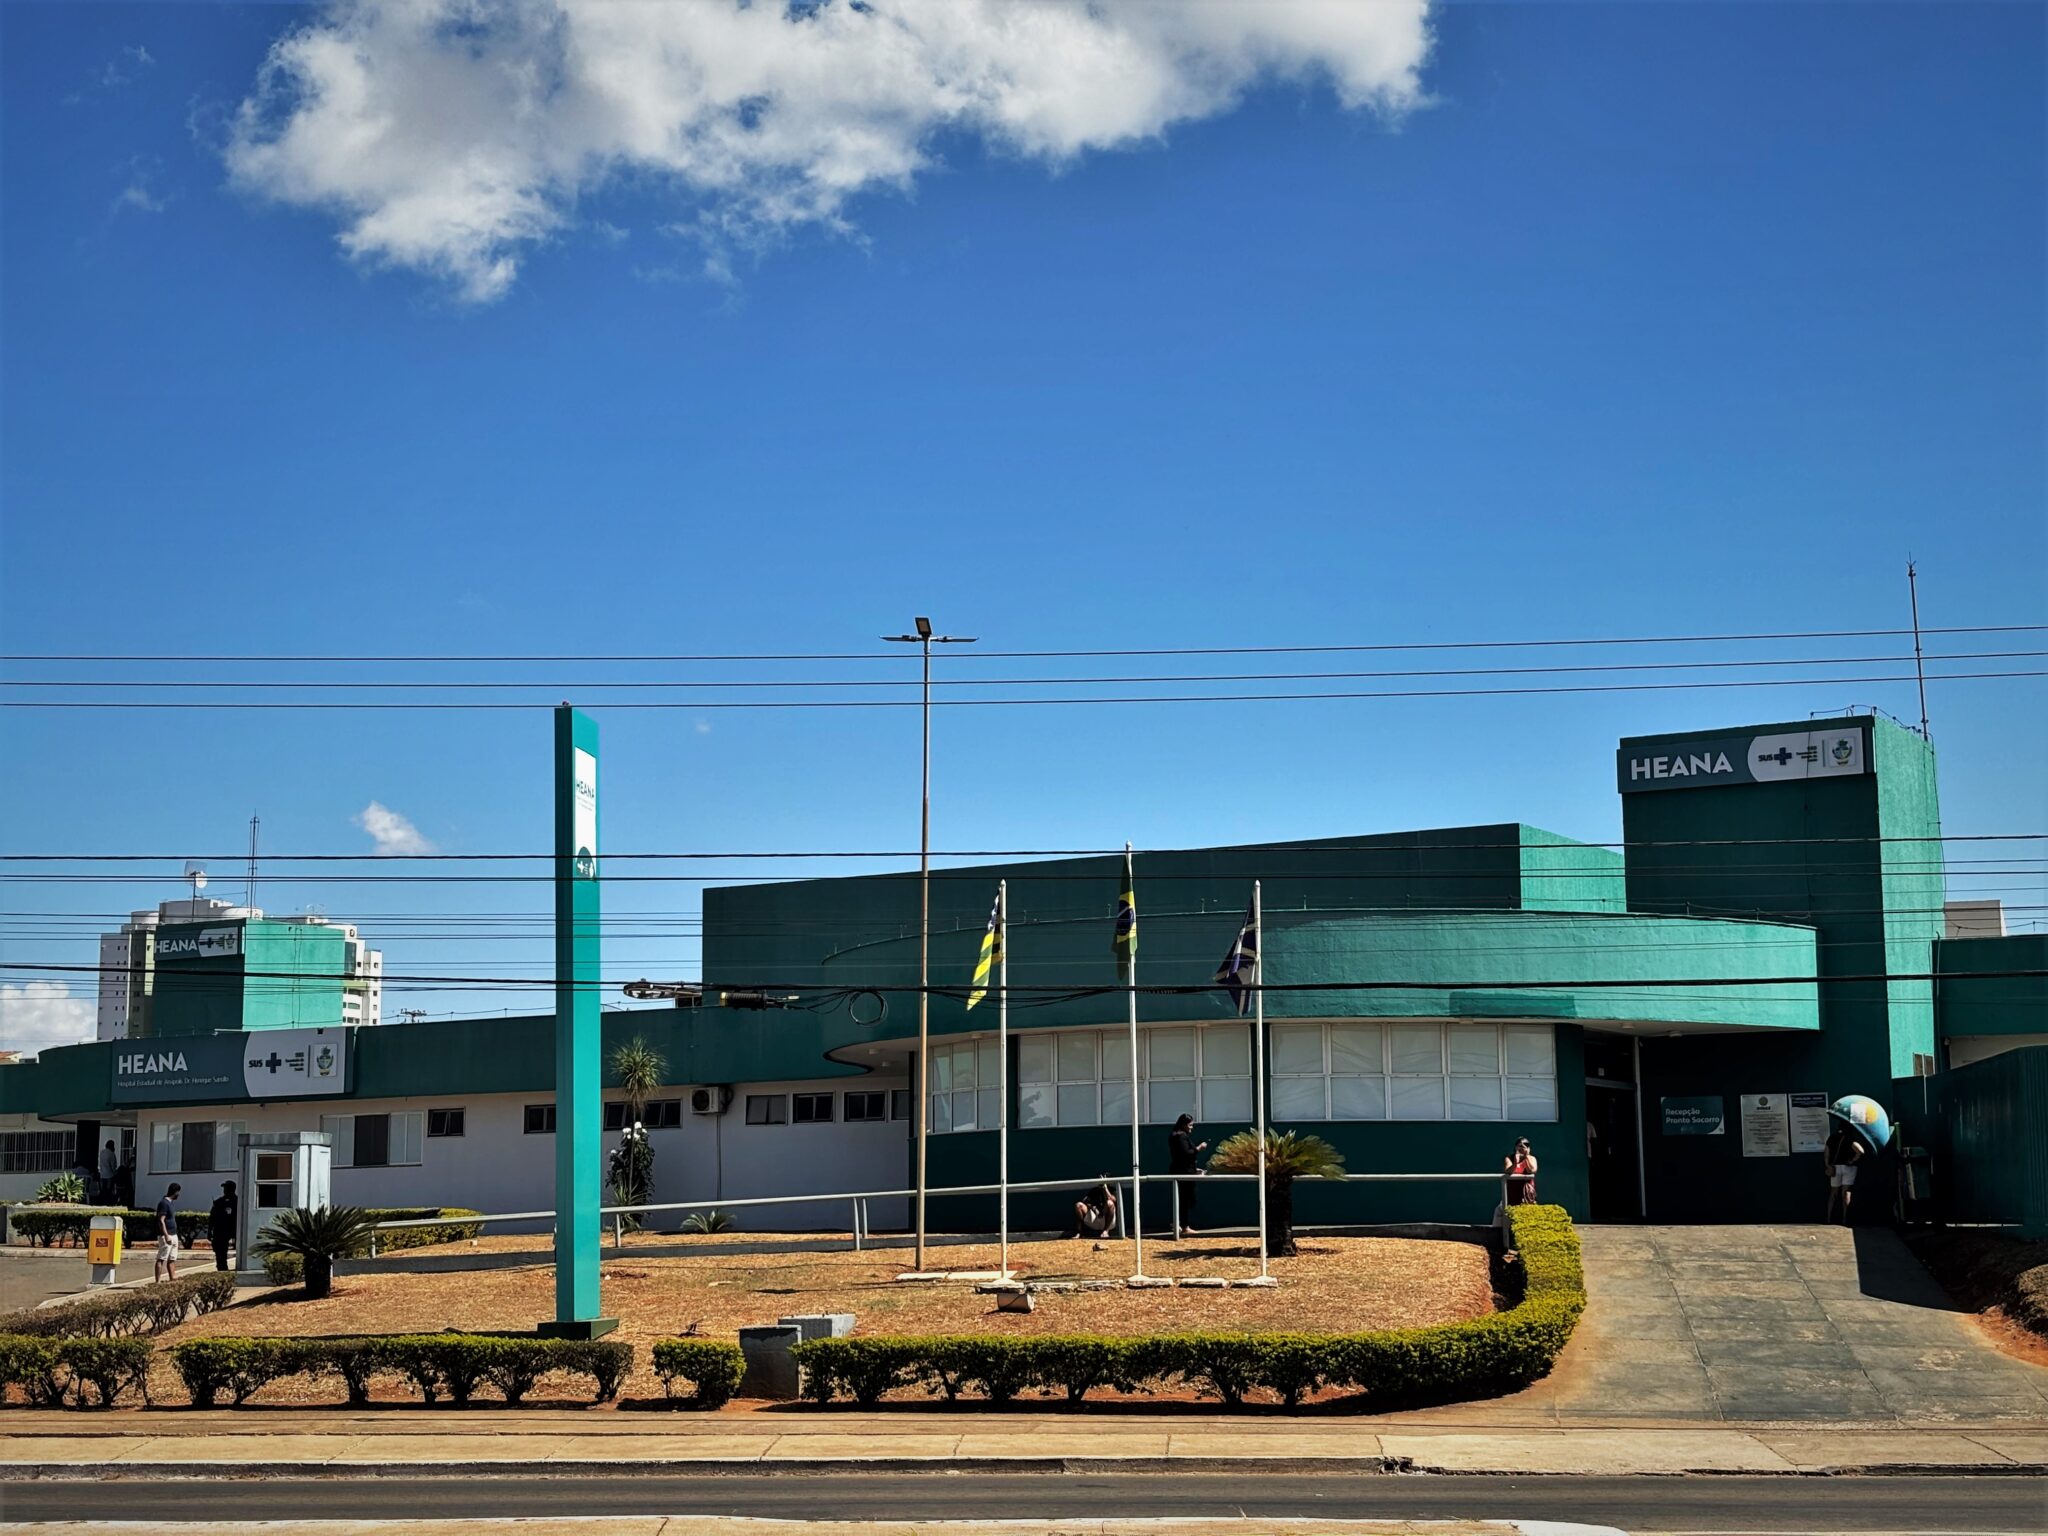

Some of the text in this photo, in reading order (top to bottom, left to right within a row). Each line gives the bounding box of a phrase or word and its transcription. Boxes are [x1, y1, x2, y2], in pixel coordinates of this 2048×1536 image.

[1758, 753, 1773, 762] SUS
[1630, 751, 1734, 780] HEANA
[154, 939, 198, 953] HEANA
[118, 1051, 188, 1075] HEANA
[248, 1059, 264, 1068] SUS
[1665, 1107, 1701, 1116] Recepção
[1665, 1116, 1720, 1124] Pronto Socorro
